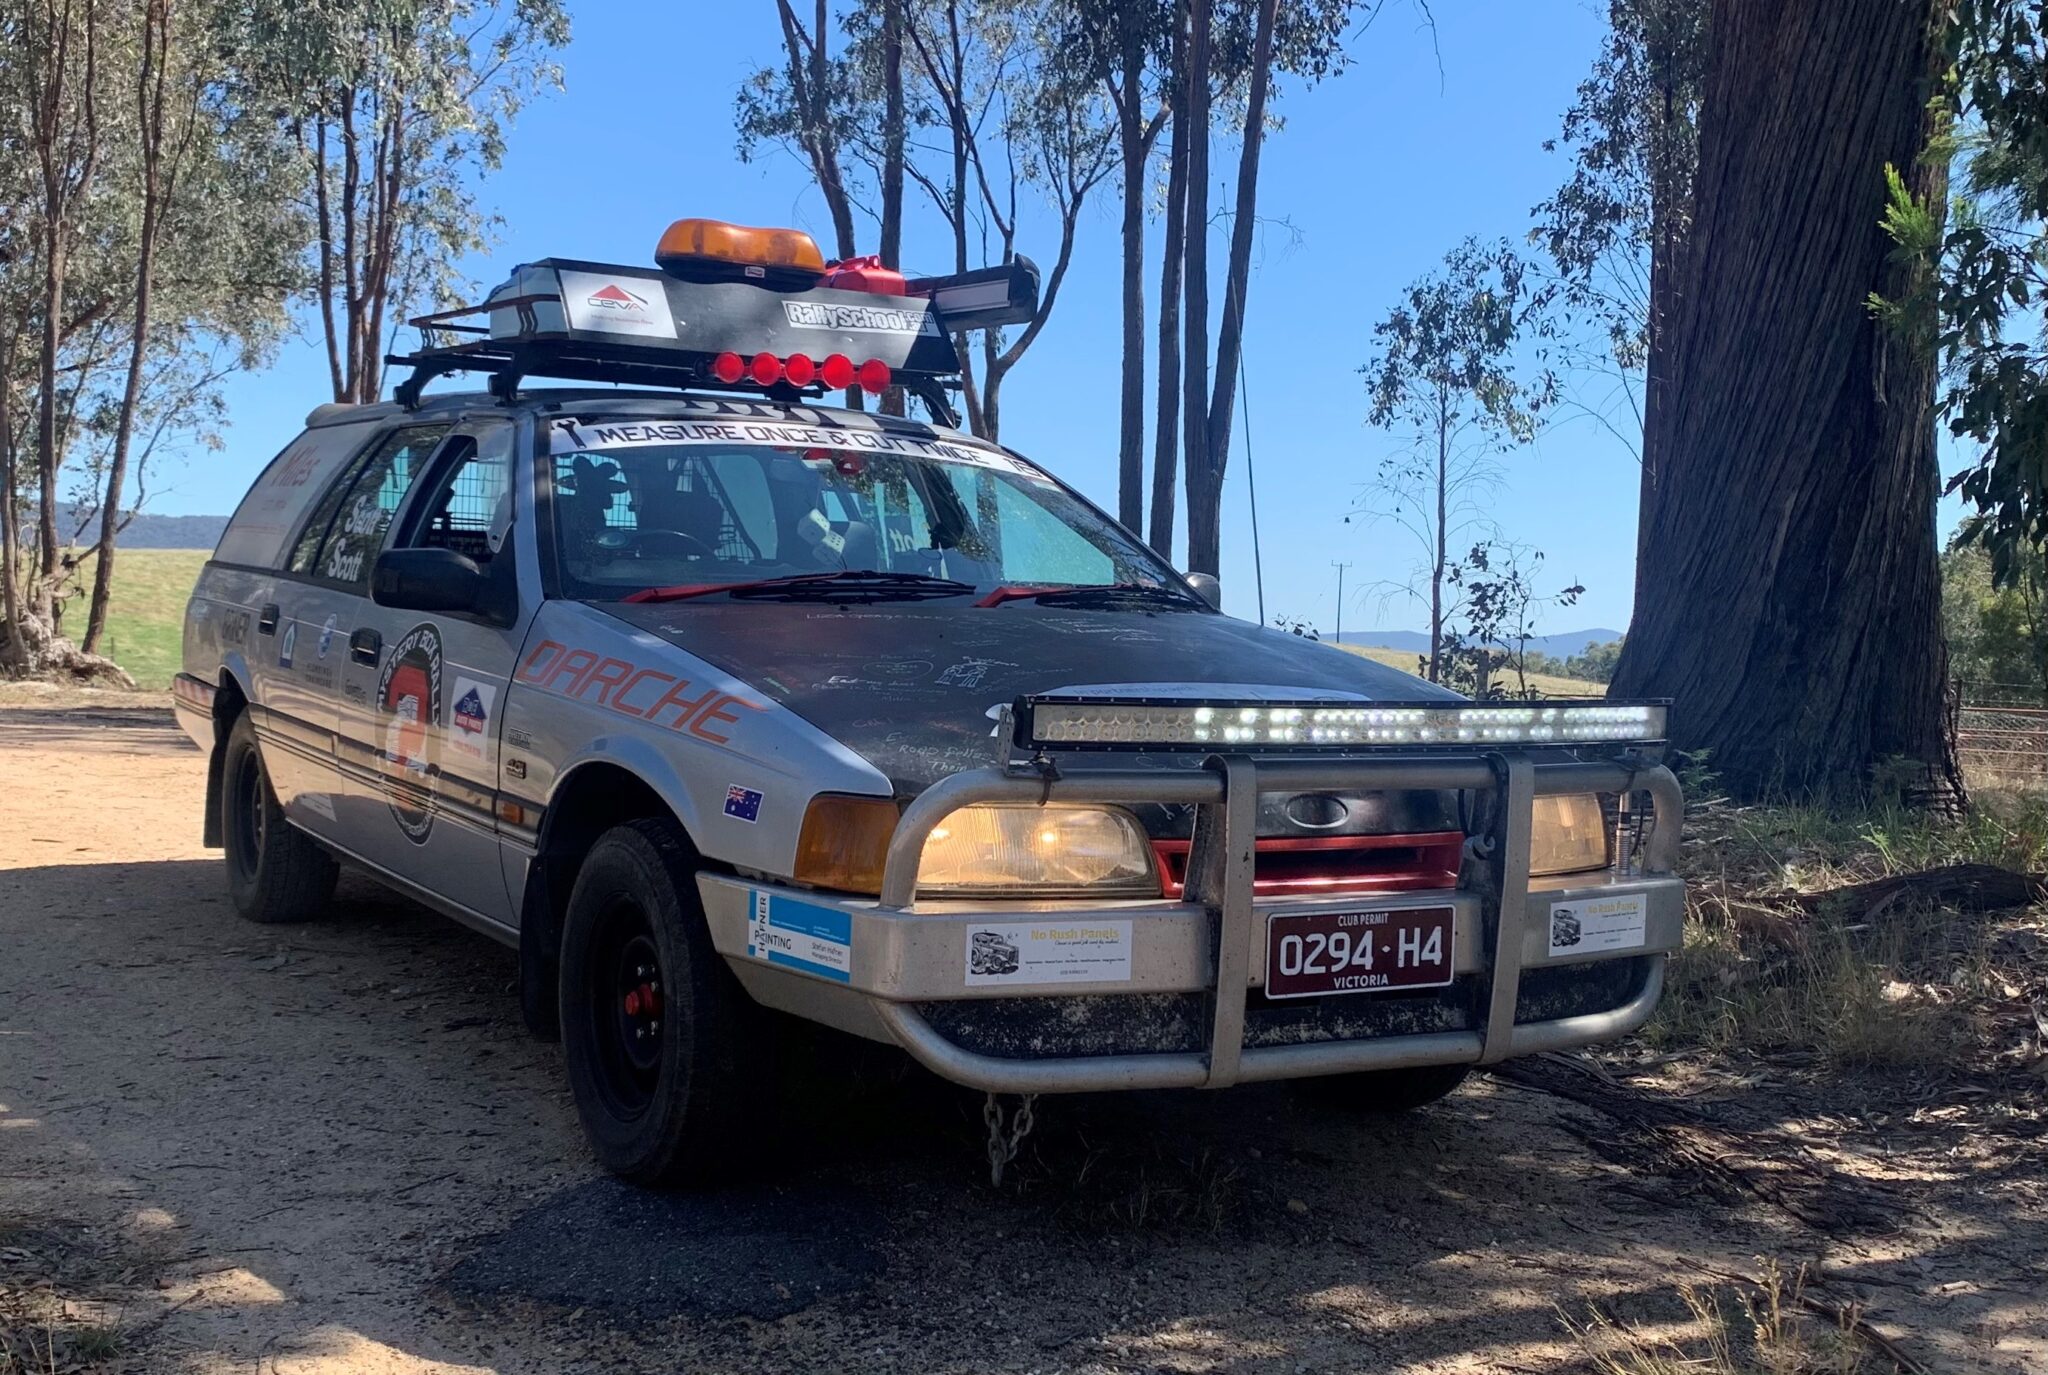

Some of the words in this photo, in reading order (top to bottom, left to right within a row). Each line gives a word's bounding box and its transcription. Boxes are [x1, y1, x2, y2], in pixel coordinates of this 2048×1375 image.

[787, 303, 906, 329] RallySchool
[594, 425, 744, 444] MEASURE
[744, 426, 827, 444] ONCE
[829, 430, 852, 447] &
[852, 433, 908, 451] CUT
[914, 441, 990, 466] TWICE
[328, 538, 364, 582] Scott
[419, 629, 438, 660] BOX
[516, 639, 769, 744] DARCHE
[1338, 915, 1358, 927] CLUB
[1360, 913, 1389, 924] PERMIT
[755, 930, 792, 950] PAINTING
[1031, 929, 1046, 940] No
[1050, 928, 1078, 939] Rush
[1081, 927, 1120, 939] Panels
[1334, 973, 1389, 989] VICTORIA
